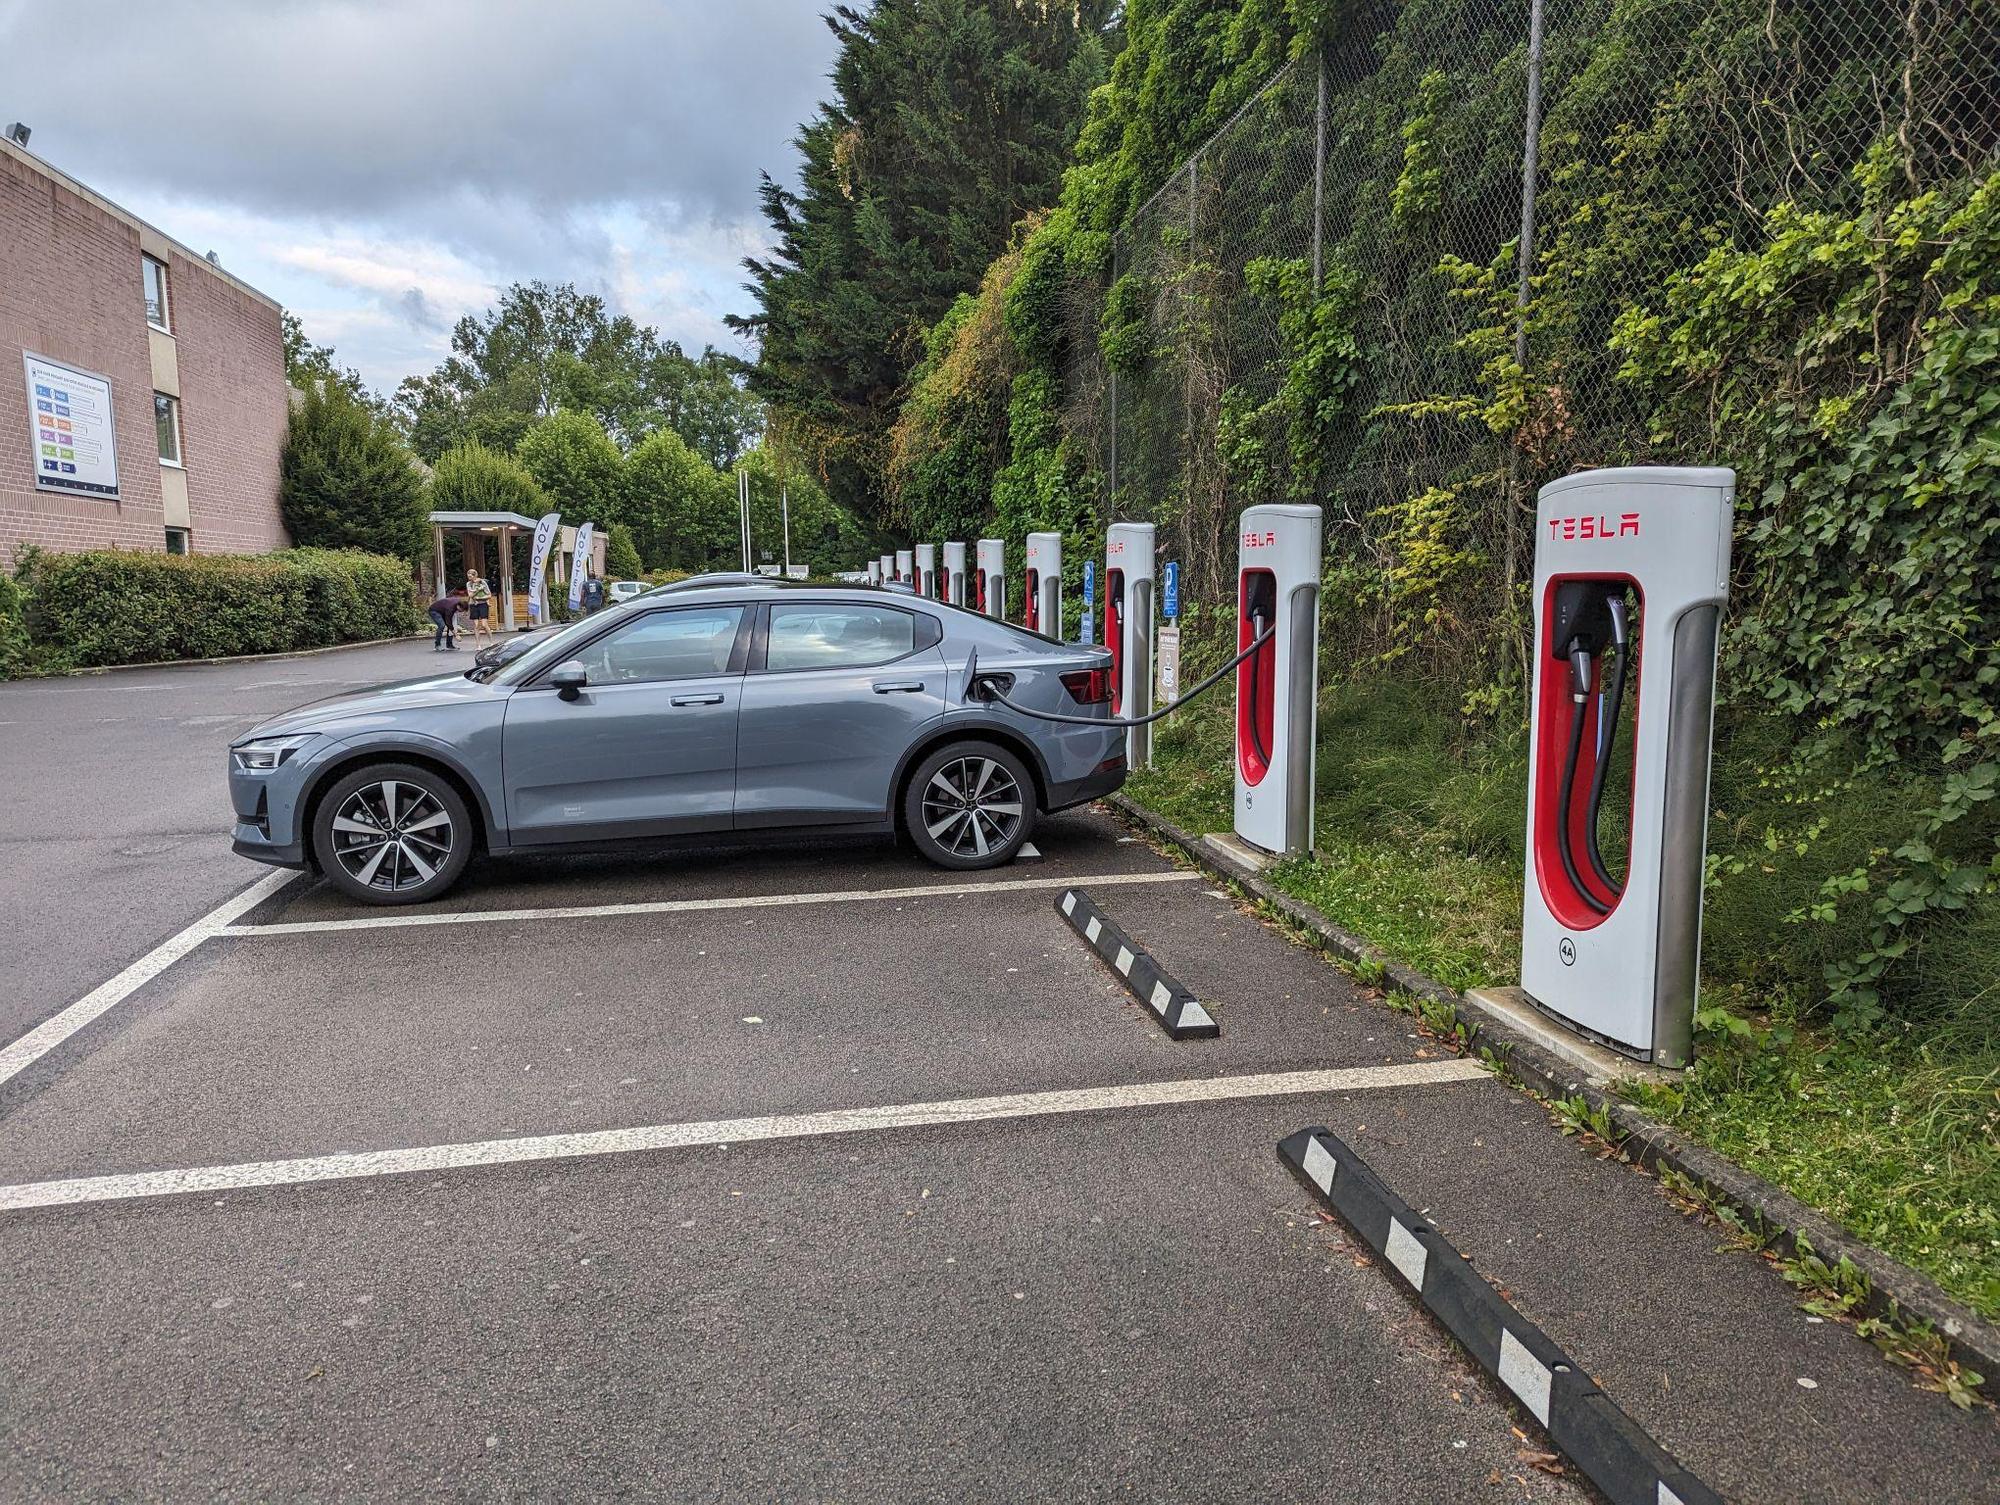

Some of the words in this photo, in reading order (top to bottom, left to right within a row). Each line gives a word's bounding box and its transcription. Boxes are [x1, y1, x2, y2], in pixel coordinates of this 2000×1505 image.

[1549, 513, 1640, 541] TESLA
[529, 522, 550, 598] NOVOTEL
[572, 531, 586, 597] NOVOTEL
[1561, 945, 1574, 958] 4A
